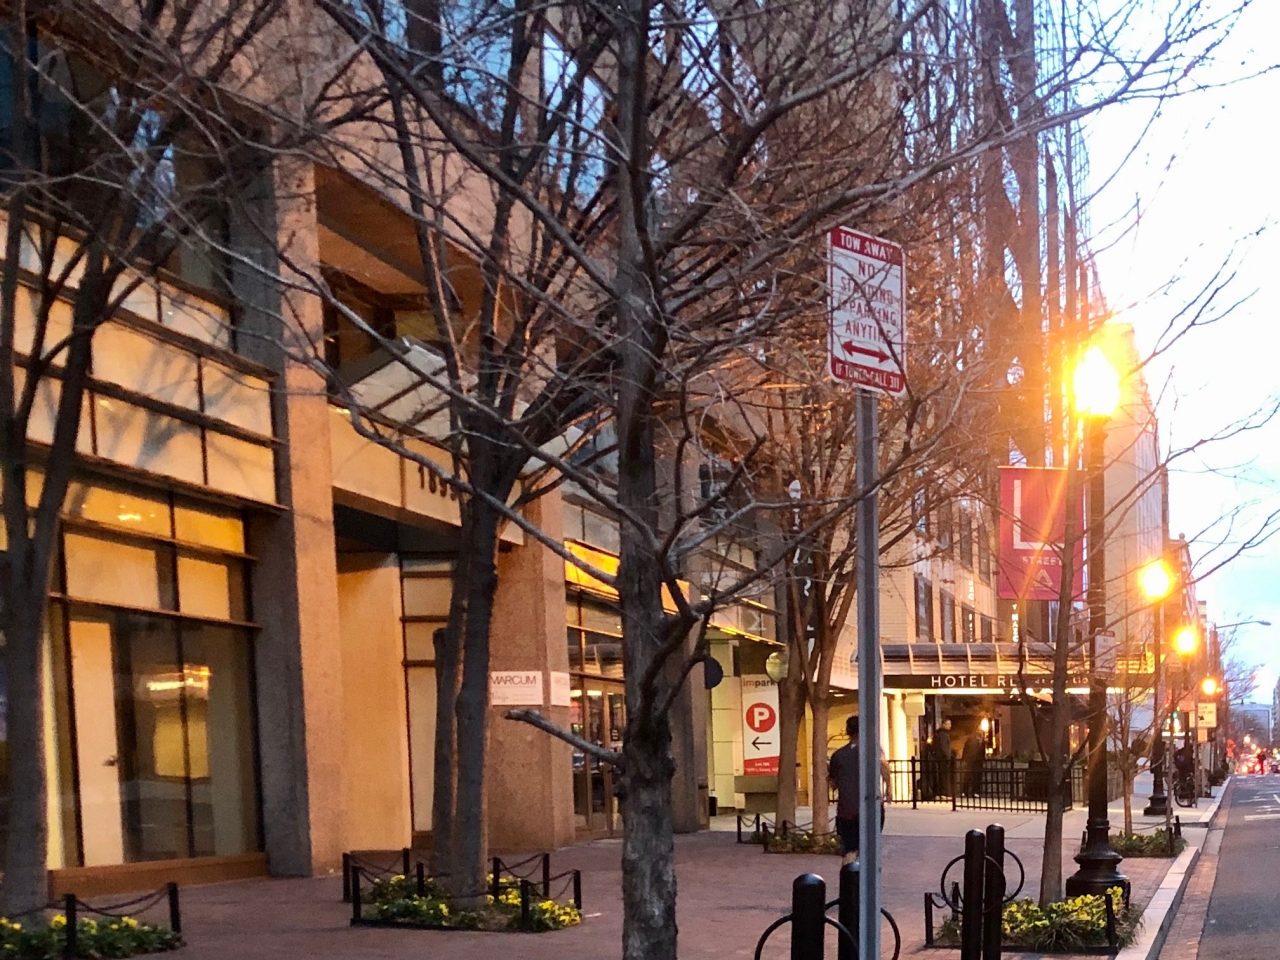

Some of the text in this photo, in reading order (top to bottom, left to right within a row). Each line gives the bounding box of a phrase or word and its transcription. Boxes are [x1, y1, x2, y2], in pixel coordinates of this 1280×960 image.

[840, 232, 893, 261] TOW AWAY
[858, 260, 876, 278] NO
[840, 275, 894, 305] STDING
[845, 319, 892, 342] ANYTIE
[488, 674, 537, 685] MARCUM
[743, 679, 777, 689] impark
[931, 675, 988, 687] HOTEL
[753, 707, 770, 728] P
